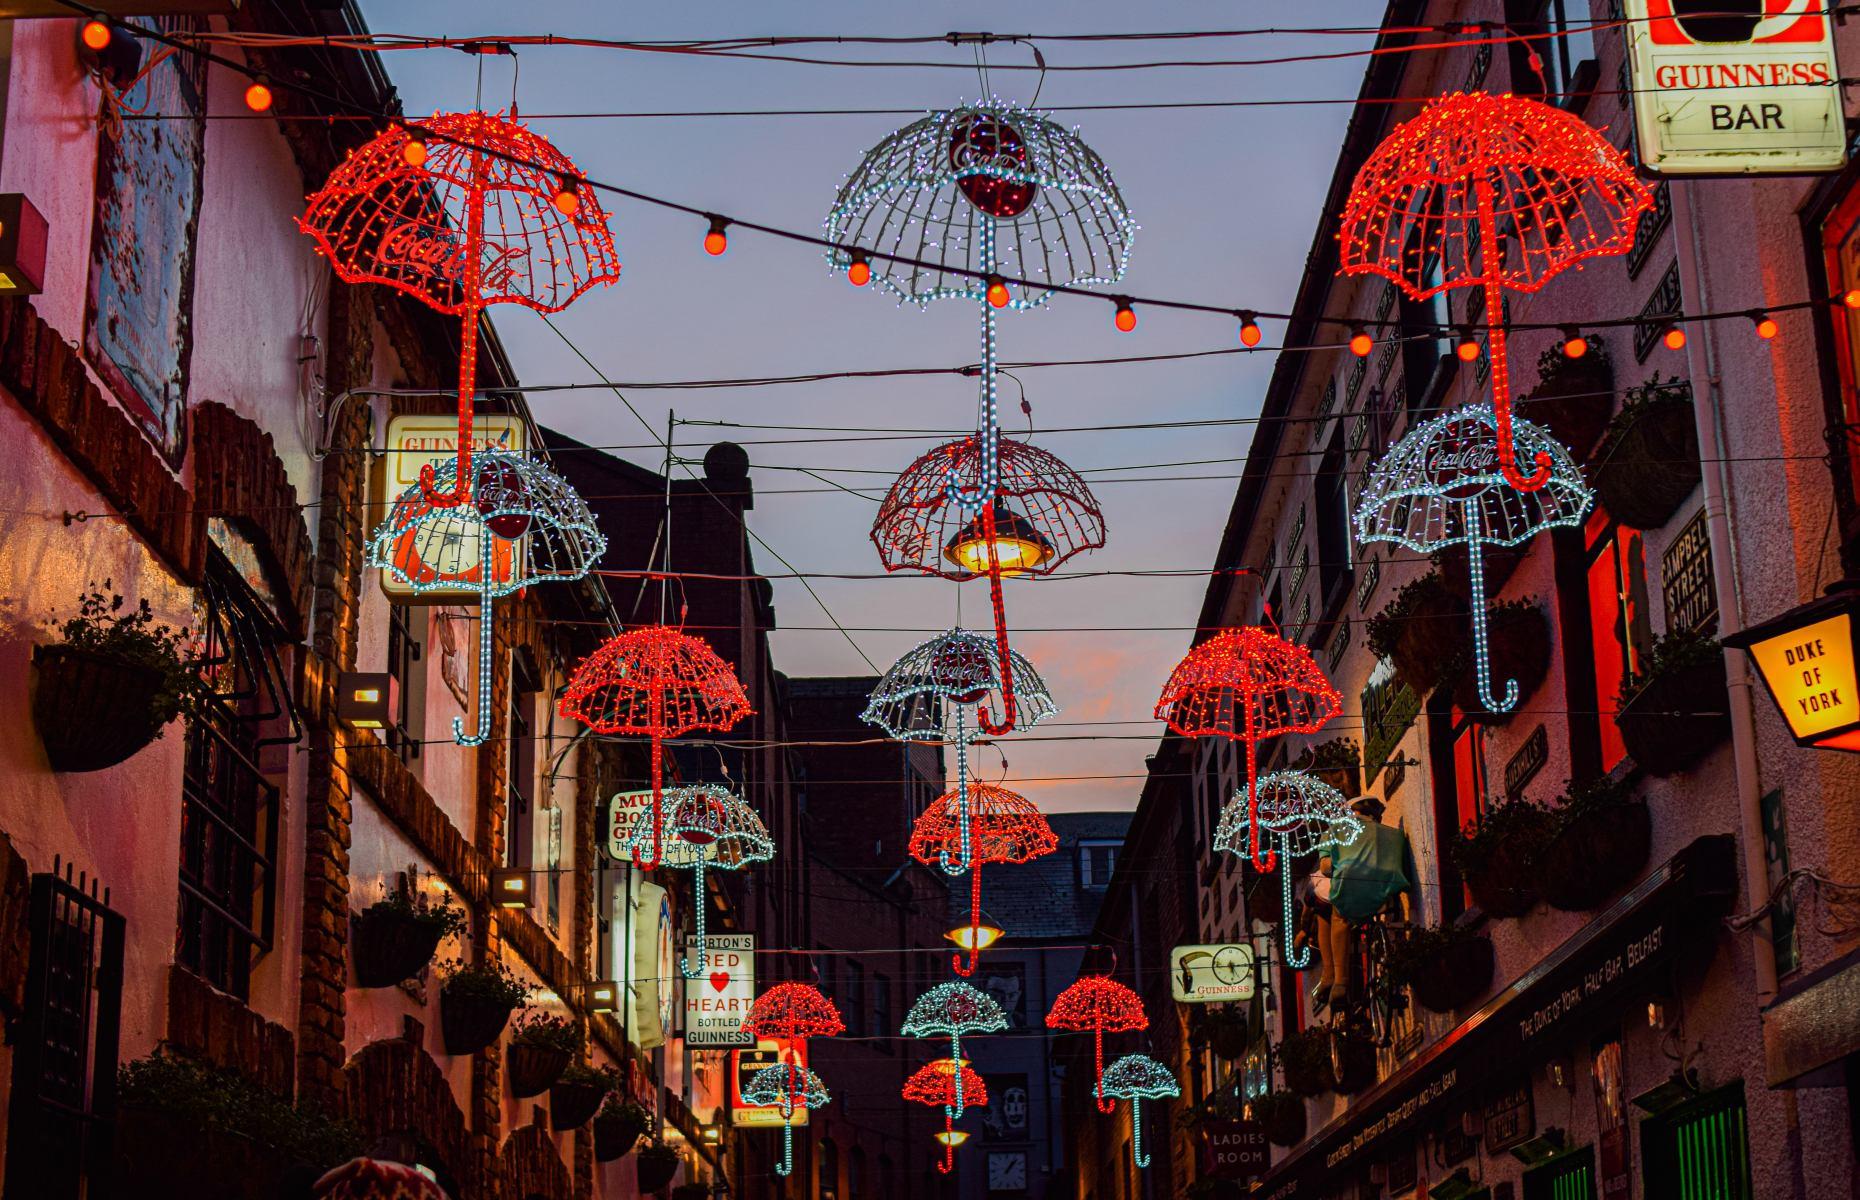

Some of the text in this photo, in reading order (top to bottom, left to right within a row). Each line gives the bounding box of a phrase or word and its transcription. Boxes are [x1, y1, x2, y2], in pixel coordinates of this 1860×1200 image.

[1656, 62, 1830, 89] GUINNESS
[1711, 103, 1785, 131] BAR
[405, 437, 508, 452] GUINESS
[1669, 545, 1710, 613] STREET
[1785, 639, 1825, 666] DUKE
[1803, 667, 1821, 687] OF
[1798, 688, 1842, 715] YORK
[690, 937, 751, 948] MRTON'S
[703, 954, 740, 967] RED
[1198, 985, 1250, 995] GUINNESS
[1519, 1015, 1534, 1041] THE
[1533, 1005, 1552, 1032] DUKE
[1627, 925, 1663, 969] BELFAST
[687, 999, 753, 1012] HEART
[698, 1018, 741, 1028] BOTTLED
[688, 1031, 751, 1043] GUINNESS
[1213, 1133, 1266, 1146] LADIES
[1217, 1151, 1263, 1164] ROOM
